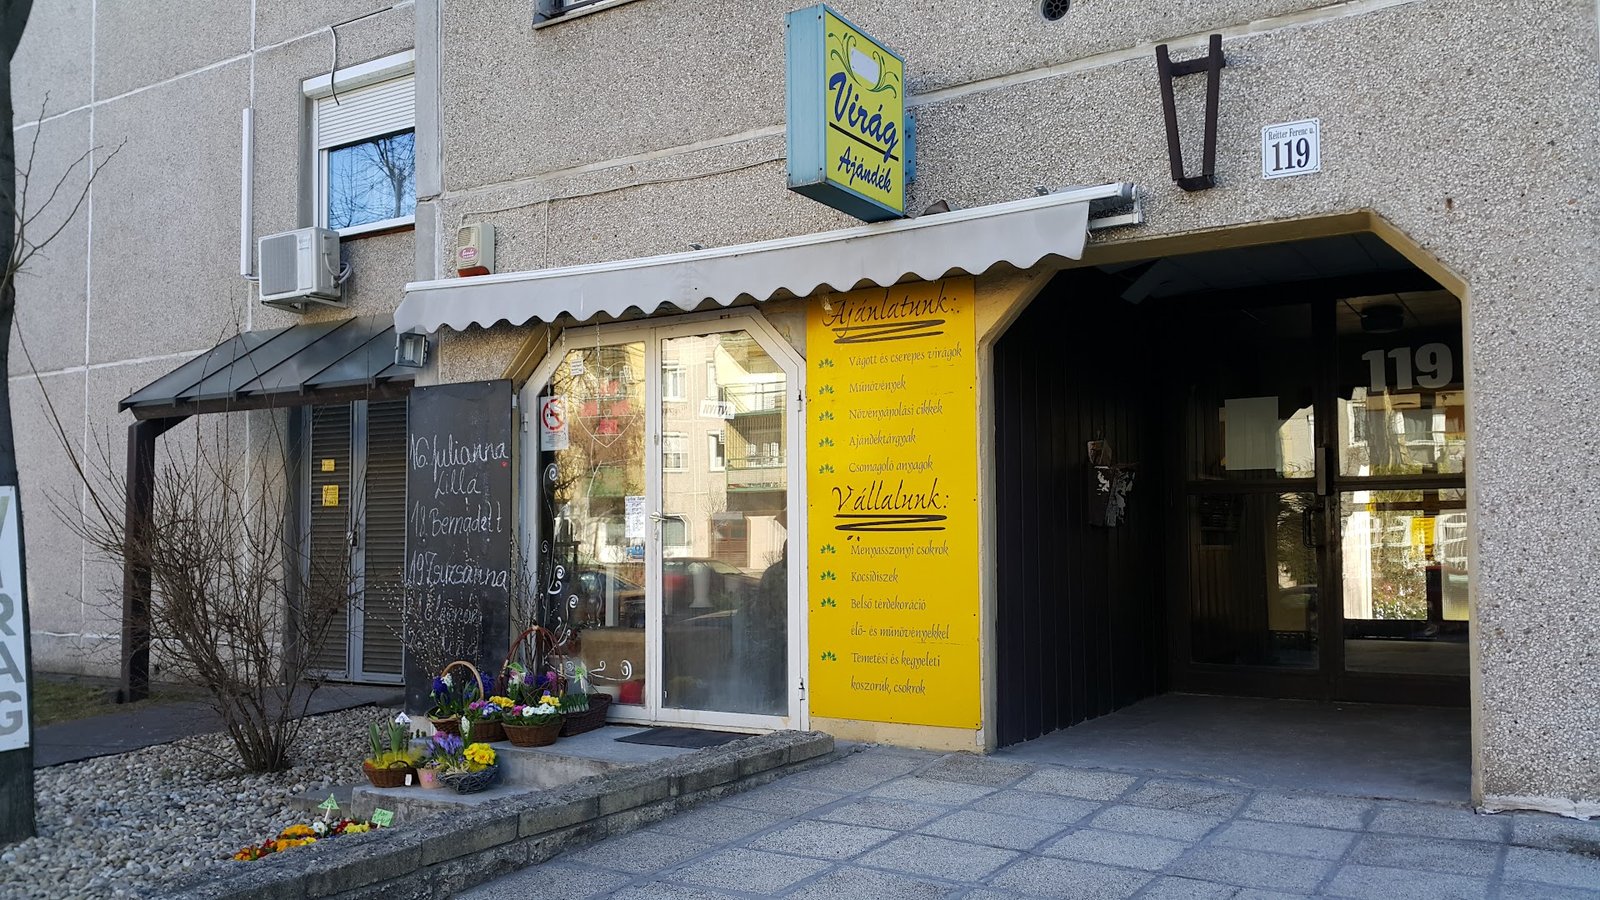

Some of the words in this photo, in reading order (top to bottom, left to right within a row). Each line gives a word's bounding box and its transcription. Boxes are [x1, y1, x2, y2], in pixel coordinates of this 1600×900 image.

[829, 72, 899, 163] Virág
[1268, 130, 1288, 140] Reitter
[1289, 127, 1308, 137] Ferenc
[1272, 137, 1310, 171] 119
[838, 146, 892, 193] Ajándék
[822, 282, 961, 337] Ajánlatunk:
[849, 354, 877, 369] Vágott
[880, 353, 888, 364] és
[890, 351, 925, 364] cserepes
[927, 341, 962, 361] virágok
[1361, 343, 1454, 392] 119
[849, 401, 914, 421] Növényápolási
[916, 399, 943, 415] cikkek
[849, 428, 916, 448] Ajándéktárgyak
[432, 433, 508, 482] Julianna
[849, 457, 894, 475] Csomagoló
[896, 455, 933, 473] anyagok
[832, 478, 950, 512] Vállalunk:
[429, 501, 502, 537] Bernadett
[851, 543, 914, 558] Menyasszonyi
[916, 540, 949, 555] csokrok
[851, 594, 872, 609] Belső
[869, 626, 877, 636] és
[851, 652, 888, 664] Temetési
[890, 653, 899, 665] és
[901, 650, 940, 669] kegyeleti
[893, 678, 926, 695] csokrok
